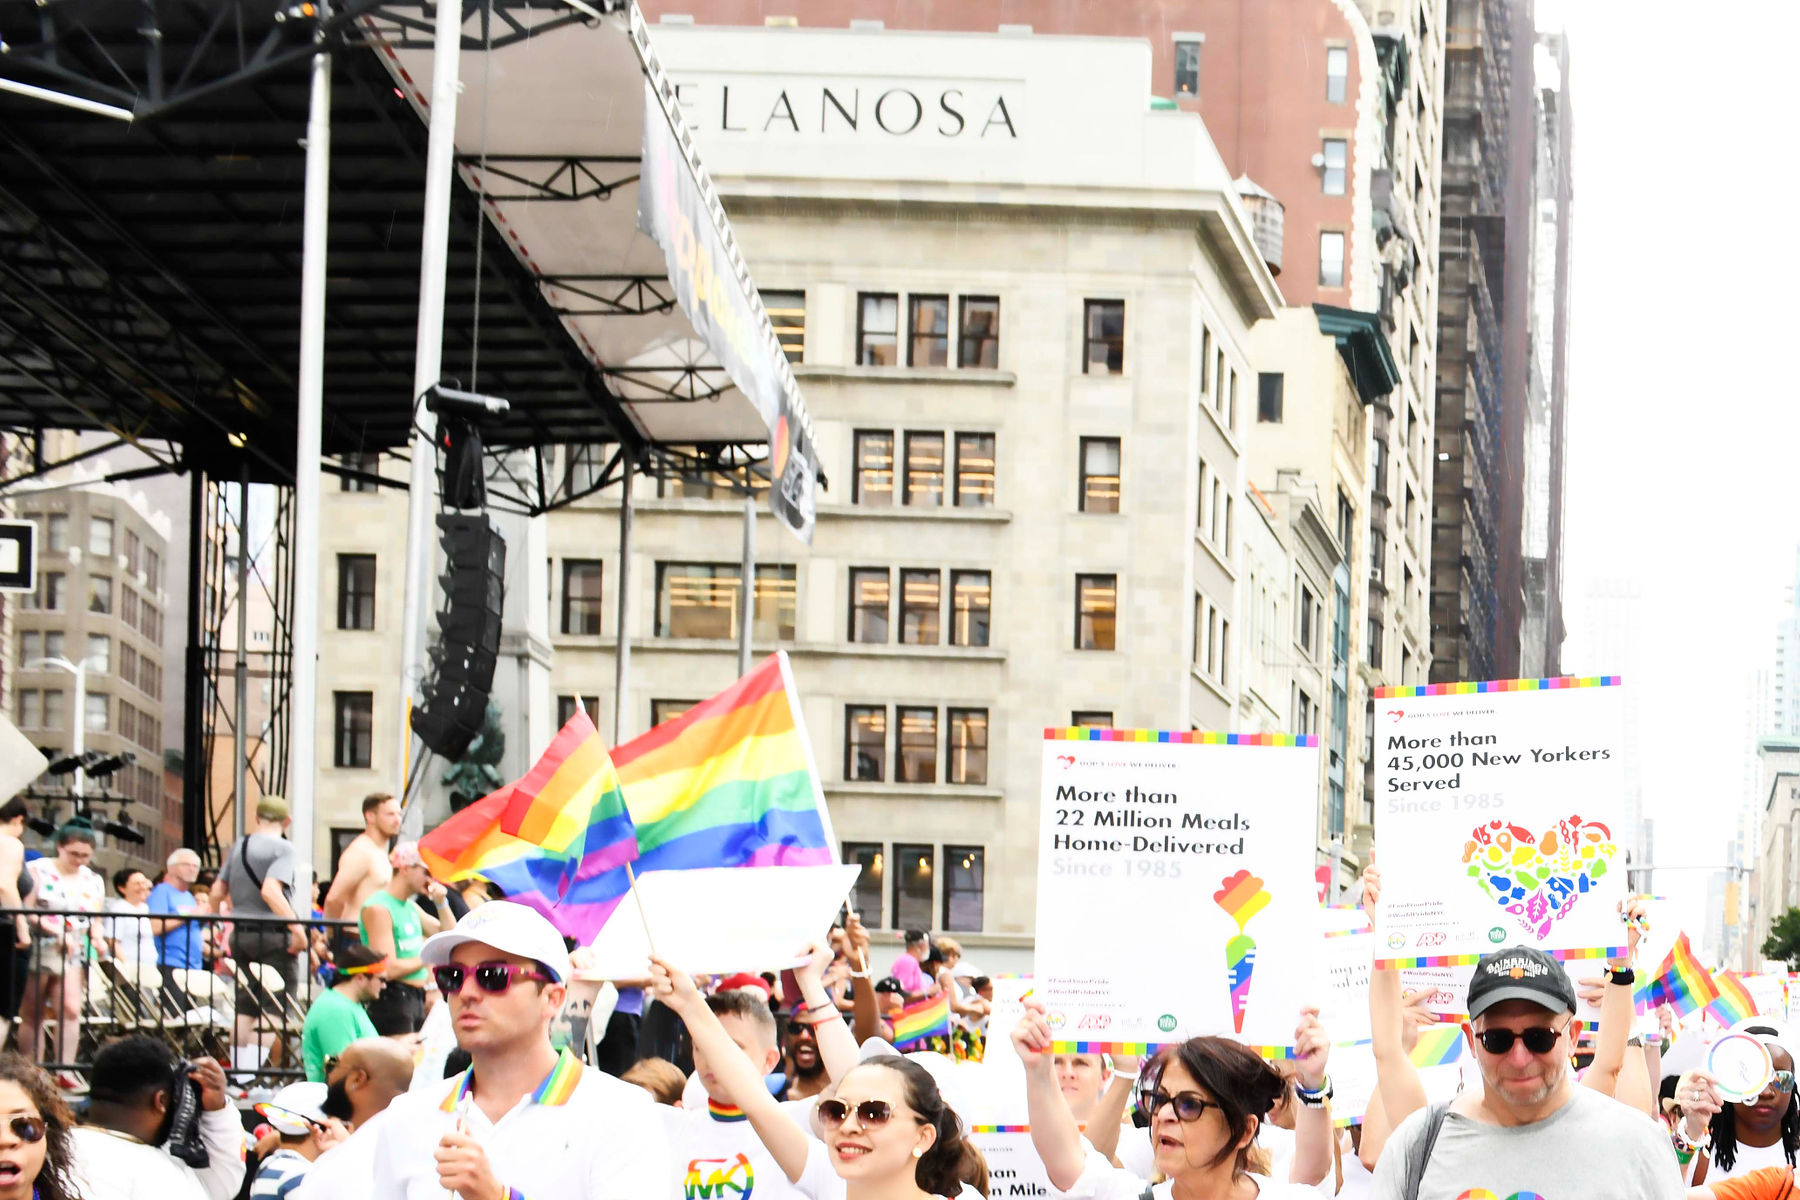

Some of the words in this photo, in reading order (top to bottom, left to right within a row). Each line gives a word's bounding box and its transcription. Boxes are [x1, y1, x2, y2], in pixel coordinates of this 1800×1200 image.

[1388, 735, 1442, 750] More
[1450, 731, 1497, 747] than
[1387, 753, 1464, 772] 45,000
[1472, 751, 1521, 766] New
[1530, 746, 1611, 763] Yorkers
[1388, 773, 1460, 792] Served
[1056, 785, 1116, 803] More
[1125, 786, 1178, 804] than
[1388, 797, 1441, 814] Since
[1452, 792, 1505, 810] 1985
[1056, 809, 1085, 826] 22
[1093, 810, 1172, 829] Million
[1181, 813, 1251, 831] Meals
[1054, 834, 1244, 855] Home-Delivered
[1053, 858, 1113, 878] Since
[1123, 859, 1182, 879] 1985
[1010, 1183, 1048, 1197] Mile
